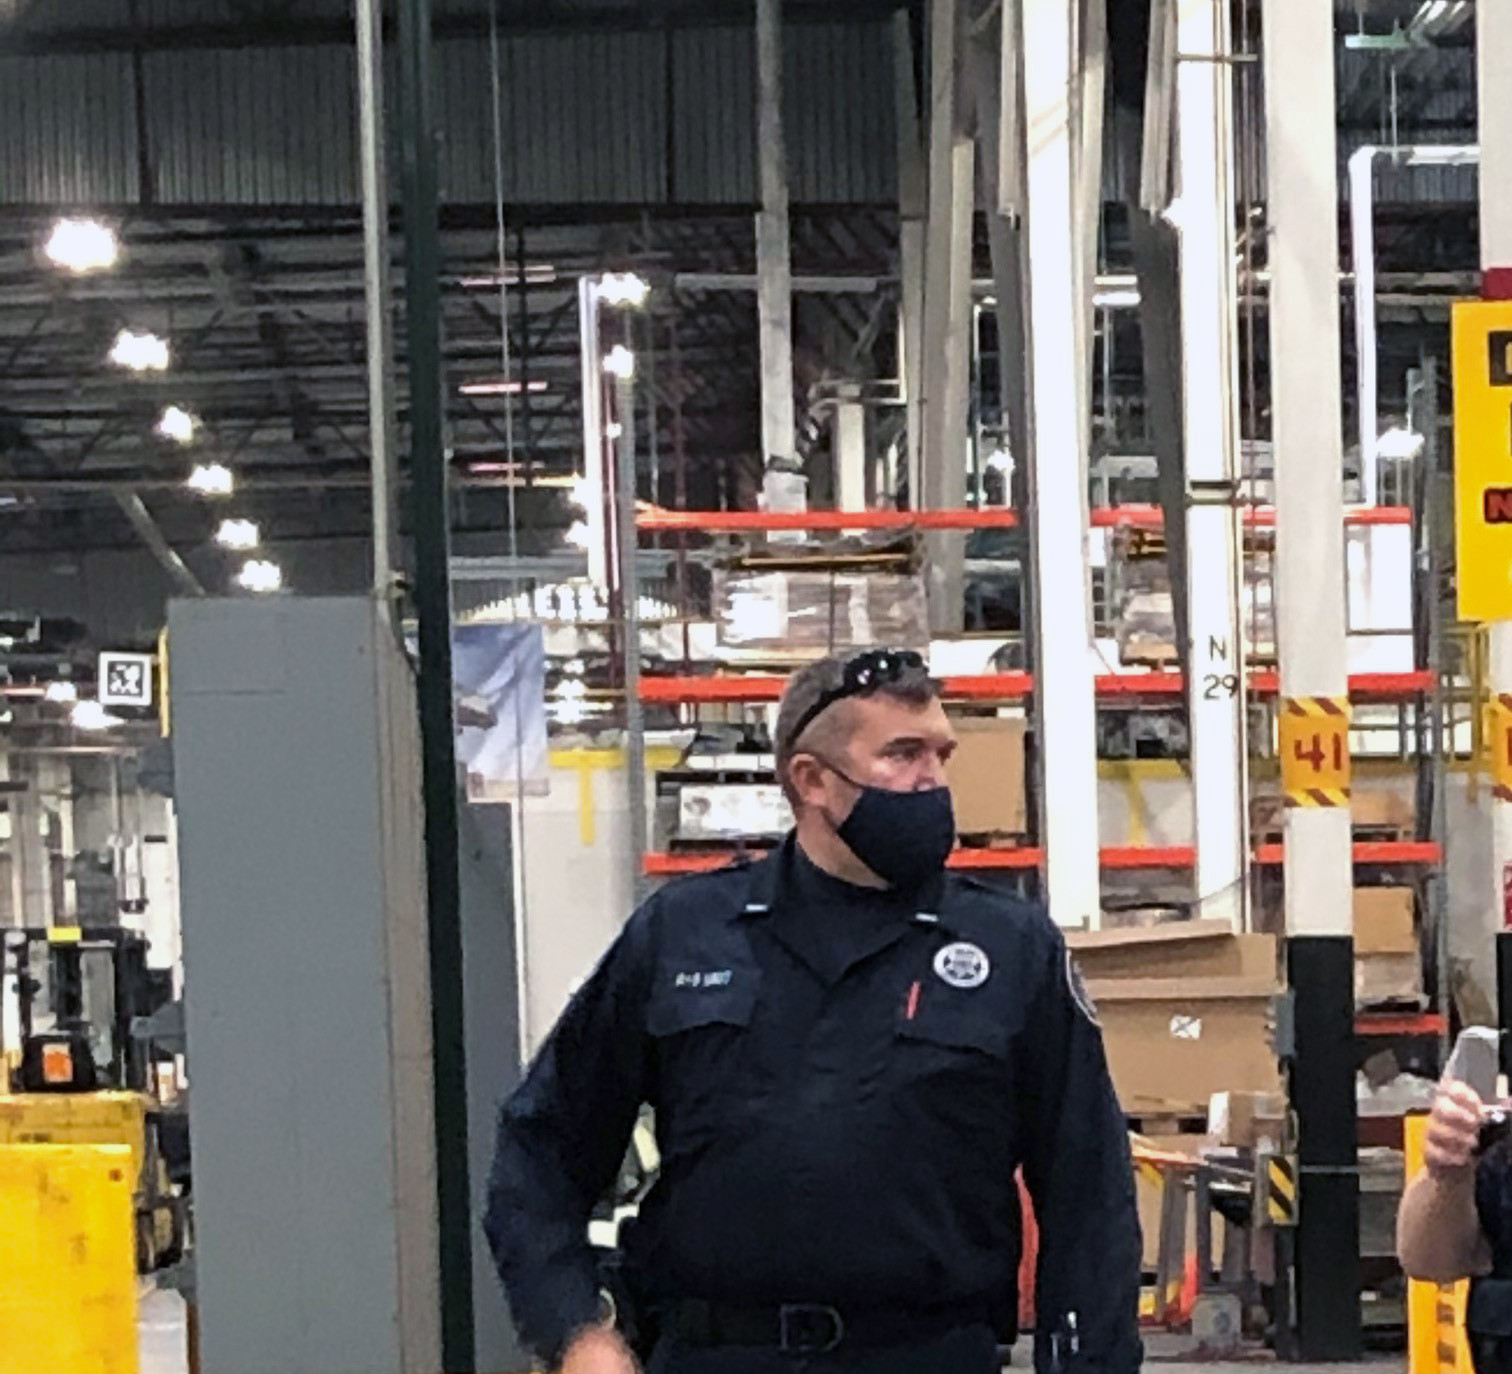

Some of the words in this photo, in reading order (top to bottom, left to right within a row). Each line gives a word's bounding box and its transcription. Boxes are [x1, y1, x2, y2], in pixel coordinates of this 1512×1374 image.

[1208, 634, 1227, 661] N
[1203, 673, 1238, 700] 29
[1294, 732, 1342, 773] 41
